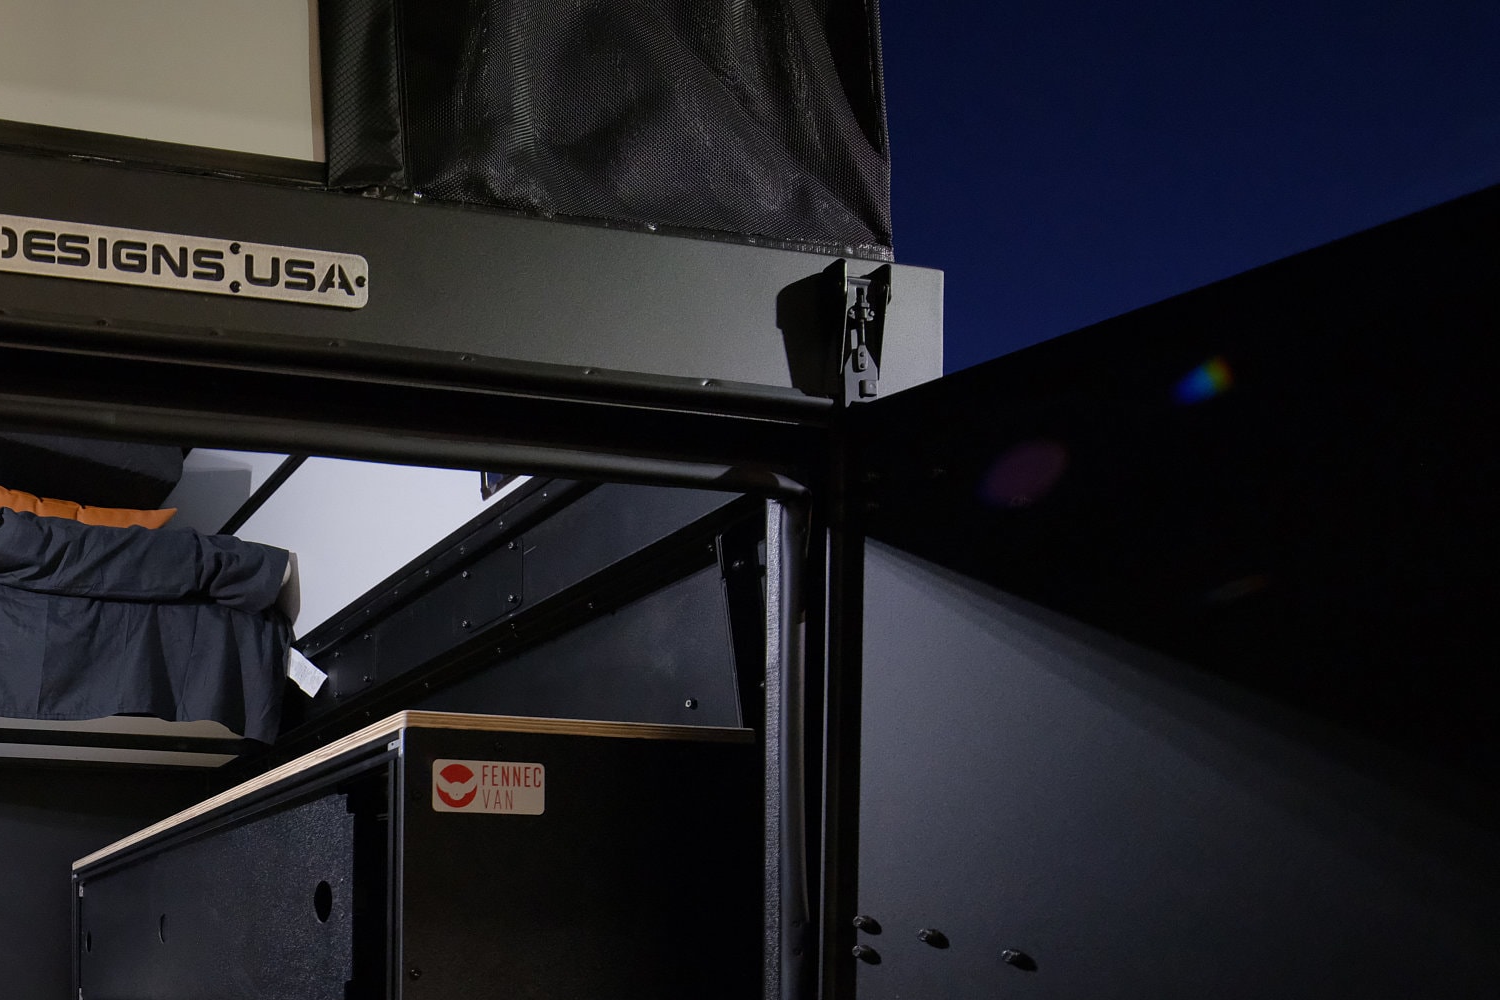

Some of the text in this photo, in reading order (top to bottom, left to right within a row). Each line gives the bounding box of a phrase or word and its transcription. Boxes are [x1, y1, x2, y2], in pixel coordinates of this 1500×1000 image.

[244, 254, 356, 296] USA
[482, 765, 542, 788] FENNEC
[482, 789, 514, 811] VAN
